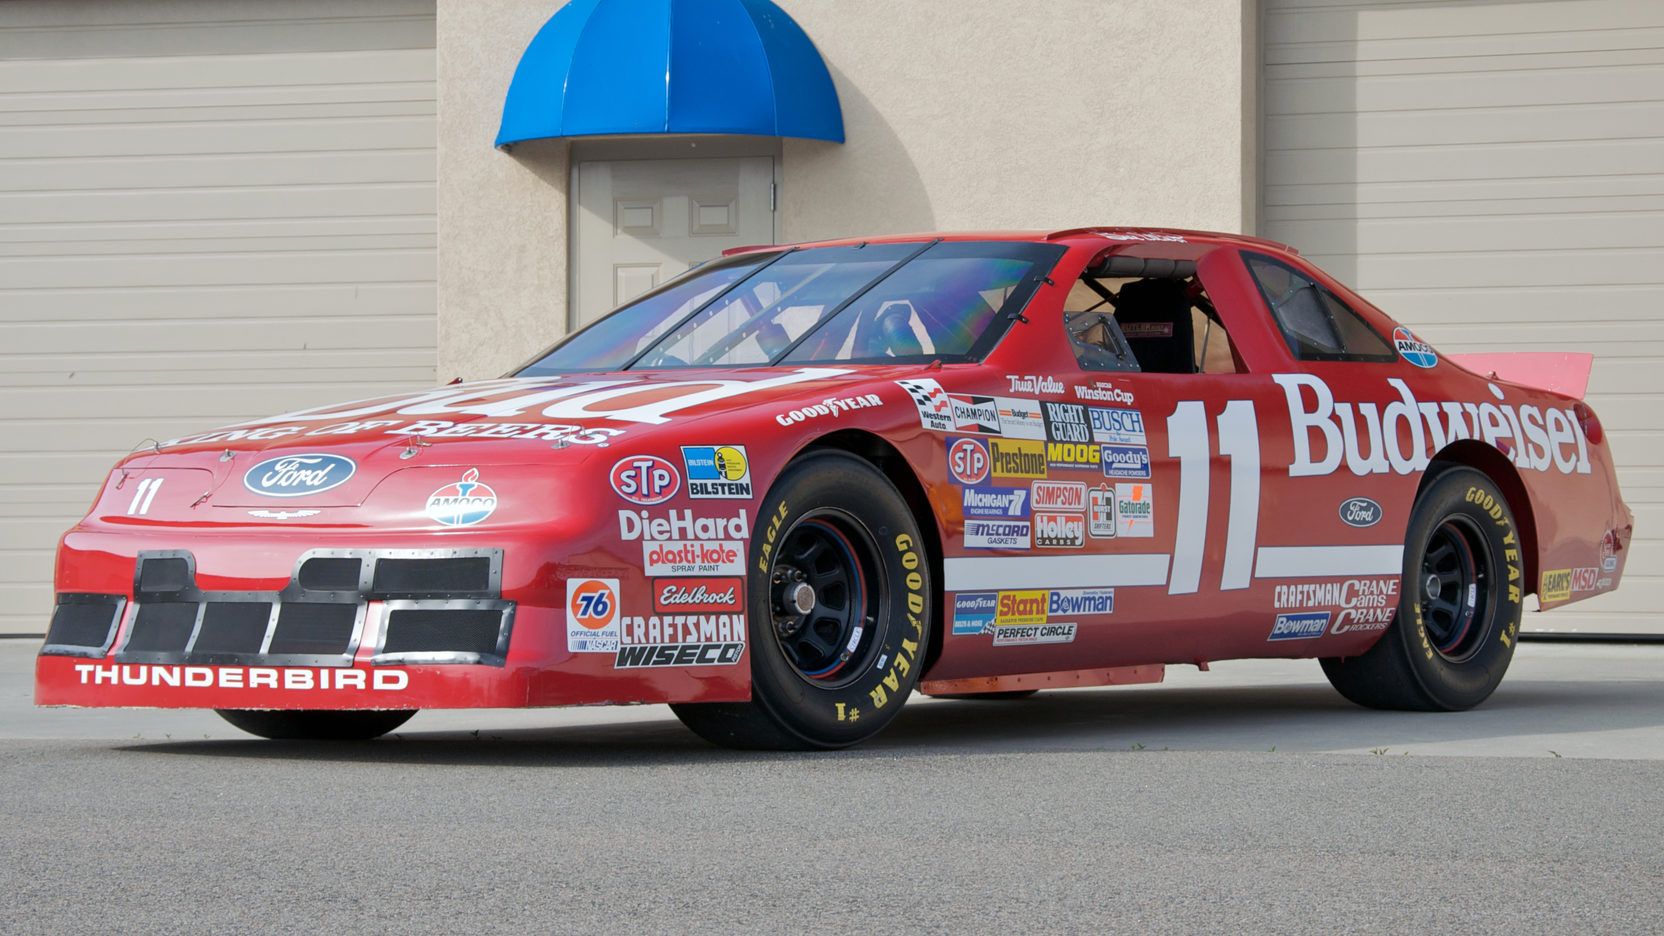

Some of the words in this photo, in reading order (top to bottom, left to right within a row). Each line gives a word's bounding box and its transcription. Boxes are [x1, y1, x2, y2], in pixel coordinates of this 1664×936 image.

[203, 367, 857, 432] ud
[1074, 386, 1114, 401] Winston
[1114, 390, 1134, 405] Cup
[776, 394, 883, 426] GOODYEAR
[921, 411, 952, 422] Western
[954, 407, 997, 422] CHAMPION
[1046, 403, 1086, 424] RIGHT
[1089, 410, 1144, 433] BUSCH
[304, 420, 404, 436] OF
[384, 420, 627, 445] BEERS
[930, 421, 947, 430] Auto
[1052, 423, 1090, 442] GUARD
[955, 444, 984, 476] STP
[991, 441, 1046, 475] Prestone
[1047, 443, 1100, 463] MOOG
[1104, 450, 1148, 469] Goody's
[261, 456, 337, 488] Ford
[620, 460, 671, 496] STP
[127, 478, 164, 515] 11
[690, 482, 751, 495] BILSTEIN
[1036, 486, 1082, 506] SIMPSON
[1166, 399, 1261, 595] 11
[1119, 500, 1151, 514] Gatorade
[1347, 501, 1374, 521] Ford
[618, 508, 750, 540] DieHard
[1037, 514, 1083, 546] Holley
[759, 500, 790, 574] EAGLE
[987, 537, 1018, 545] GASKETS
[1465, 486, 1521, 604] GOODYEAR
[648, 543, 738, 567] plasti-kote
[671, 565, 696, 573] SPRAY
[698, 564, 719, 572] PAINT
[1571, 568, 1598, 590] MSD
[577, 590, 610, 618] 76
[660, 585, 736, 606] Edelbrock
[956, 598, 996, 609] GOODYEAR
[999, 593, 1047, 617] Stant
[1048, 591, 1113, 614] Bowman
[1274, 582, 1341, 609] CRAFTSMAN
[1340, 579, 1400, 608] CRANE
[621, 614, 746, 644] CRAFTSMAN
[868, 532, 923, 709] GOODYEAR
[997, 627, 1040, 639] PERFECT
[1041, 625, 1074, 637] CIRCLE
[1274, 616, 1327, 634] Bowman
[1330, 607, 1396, 635] CRANE
[570, 630, 601, 638] OFFICIAL
[601, 630, 618, 638] FUEL
[616, 643, 744, 668] WISECO
[75, 664, 410, 691] THUNDERBIRD
